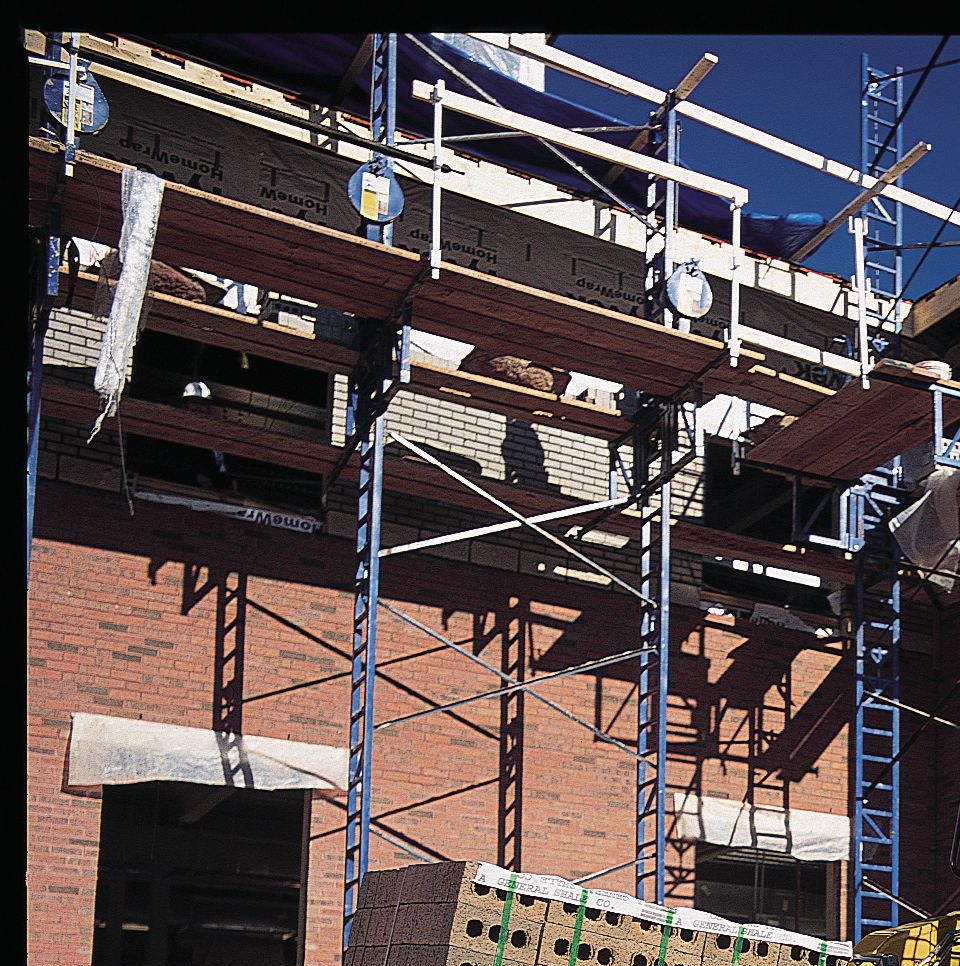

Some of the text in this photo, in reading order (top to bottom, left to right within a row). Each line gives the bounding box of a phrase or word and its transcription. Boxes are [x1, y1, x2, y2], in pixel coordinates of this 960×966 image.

[119, 137, 224, 182] HomeWrap
[410, 227, 498, 265] HomeWap
[576, 277, 645, 304] omeWrap
[478, 874, 486, 883] A
[497, 877, 549, 896] GENERAL
[675, 918, 683, 926] A
[693, 920, 738, 935] GENERAL
